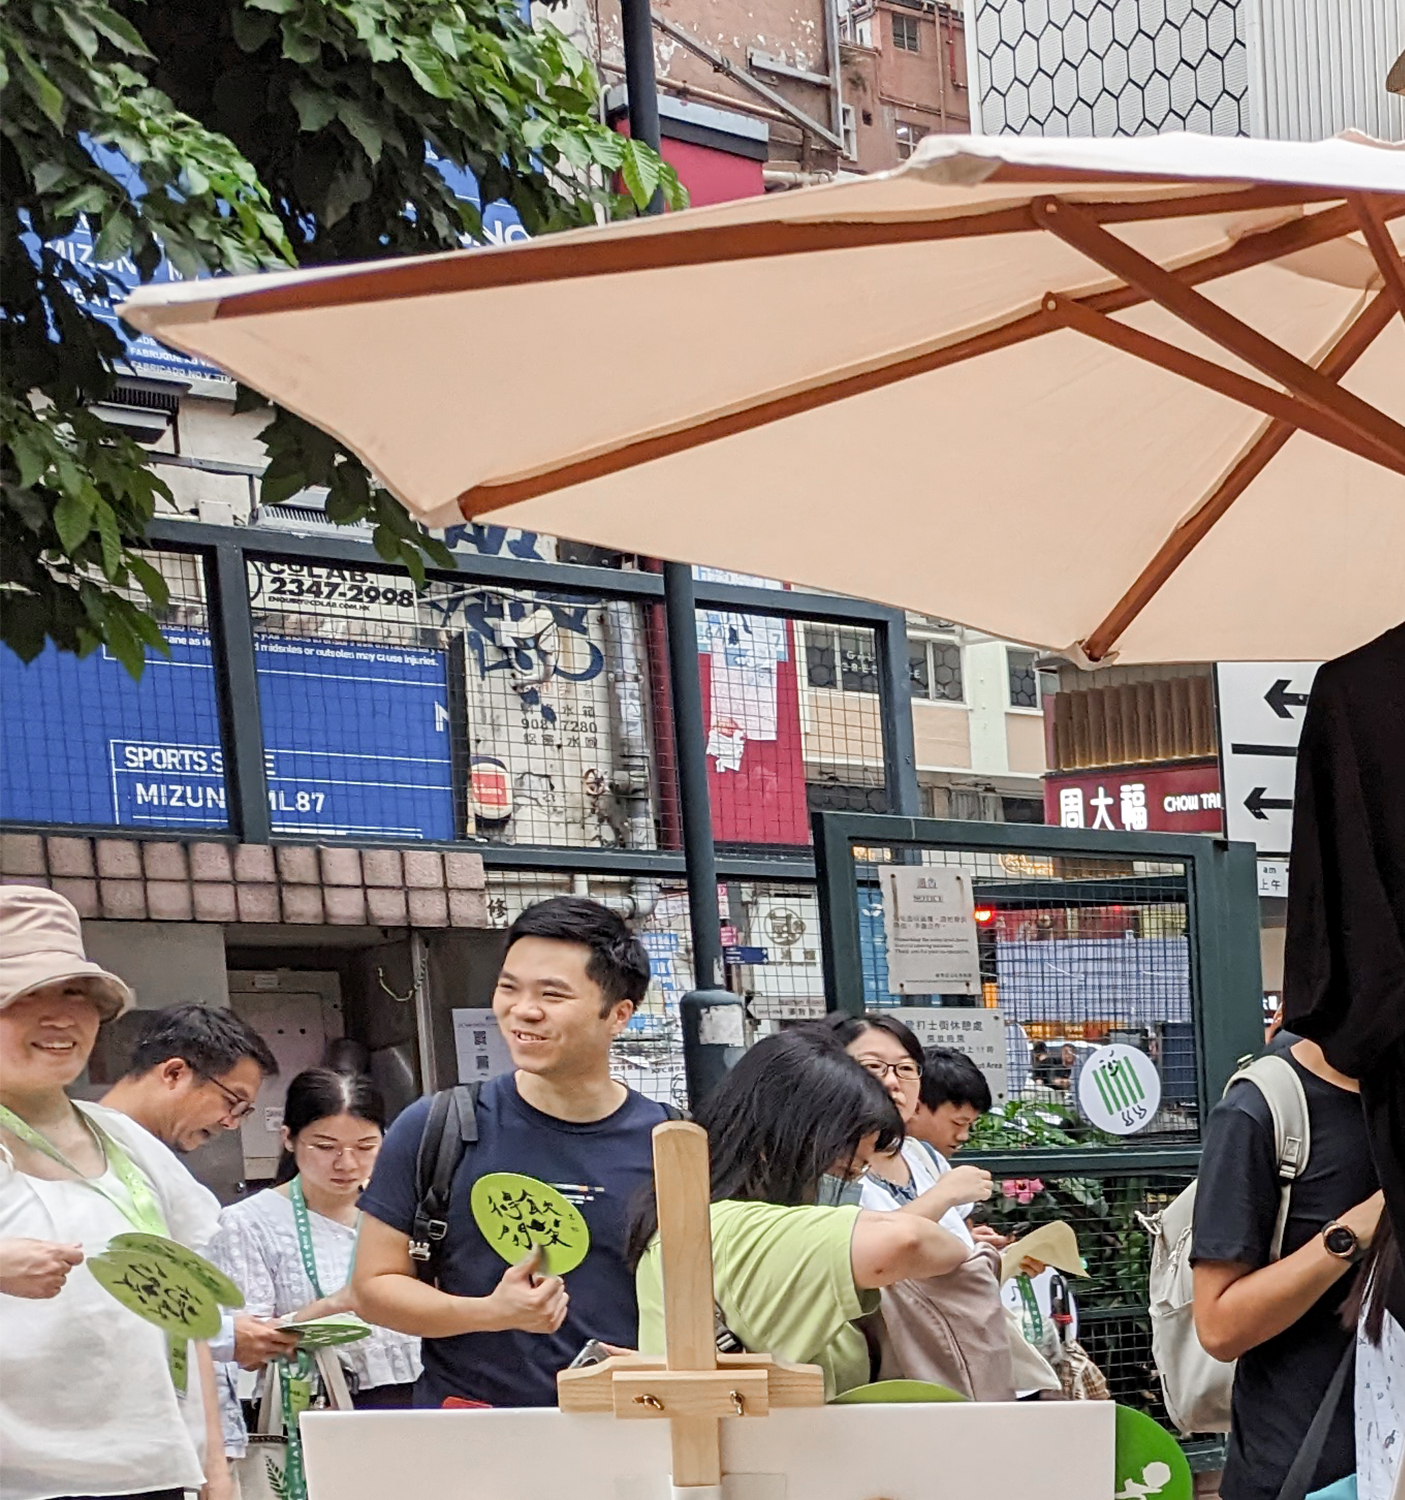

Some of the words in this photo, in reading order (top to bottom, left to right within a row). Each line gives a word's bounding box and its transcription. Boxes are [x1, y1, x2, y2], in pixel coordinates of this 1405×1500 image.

[270, 578, 414, 608] 2347-2998
[304, 646, 315, 656] or
[355, 651, 375, 663] may
[376, 653, 403, 664] cause
[123, 746, 208, 772] SPORTS
[135, 782, 226, 809] MIZUN
[1163, 795, 1198, 813] CHOW
[1059, 783, 1148, 831] 周大福
[1262, 866, 1277, 875] am
[1259, 878, 1281, 891] 上午
